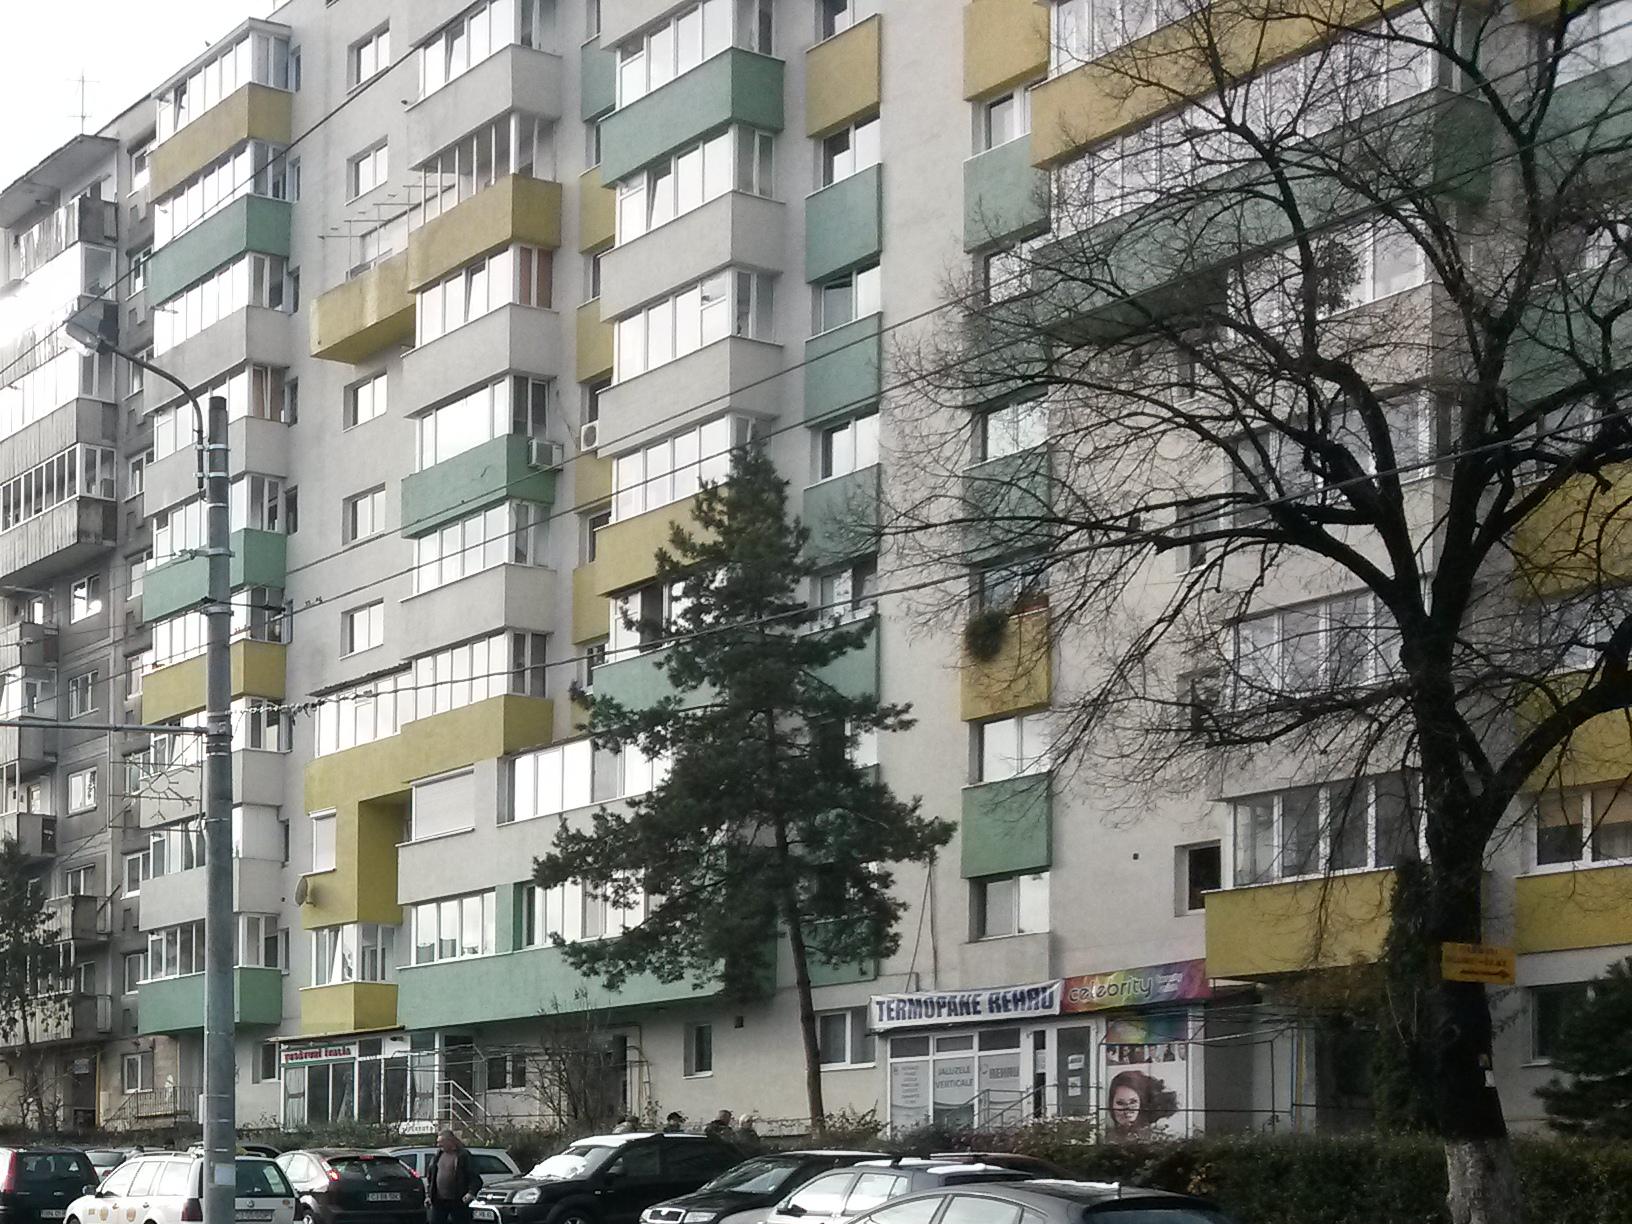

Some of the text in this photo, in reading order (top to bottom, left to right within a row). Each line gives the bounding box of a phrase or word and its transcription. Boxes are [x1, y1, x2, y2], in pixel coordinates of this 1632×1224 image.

[876, 985, 1055, 1022] TERMOPANE REHAU
[1069, 976, 1152, 1002] celebrity
